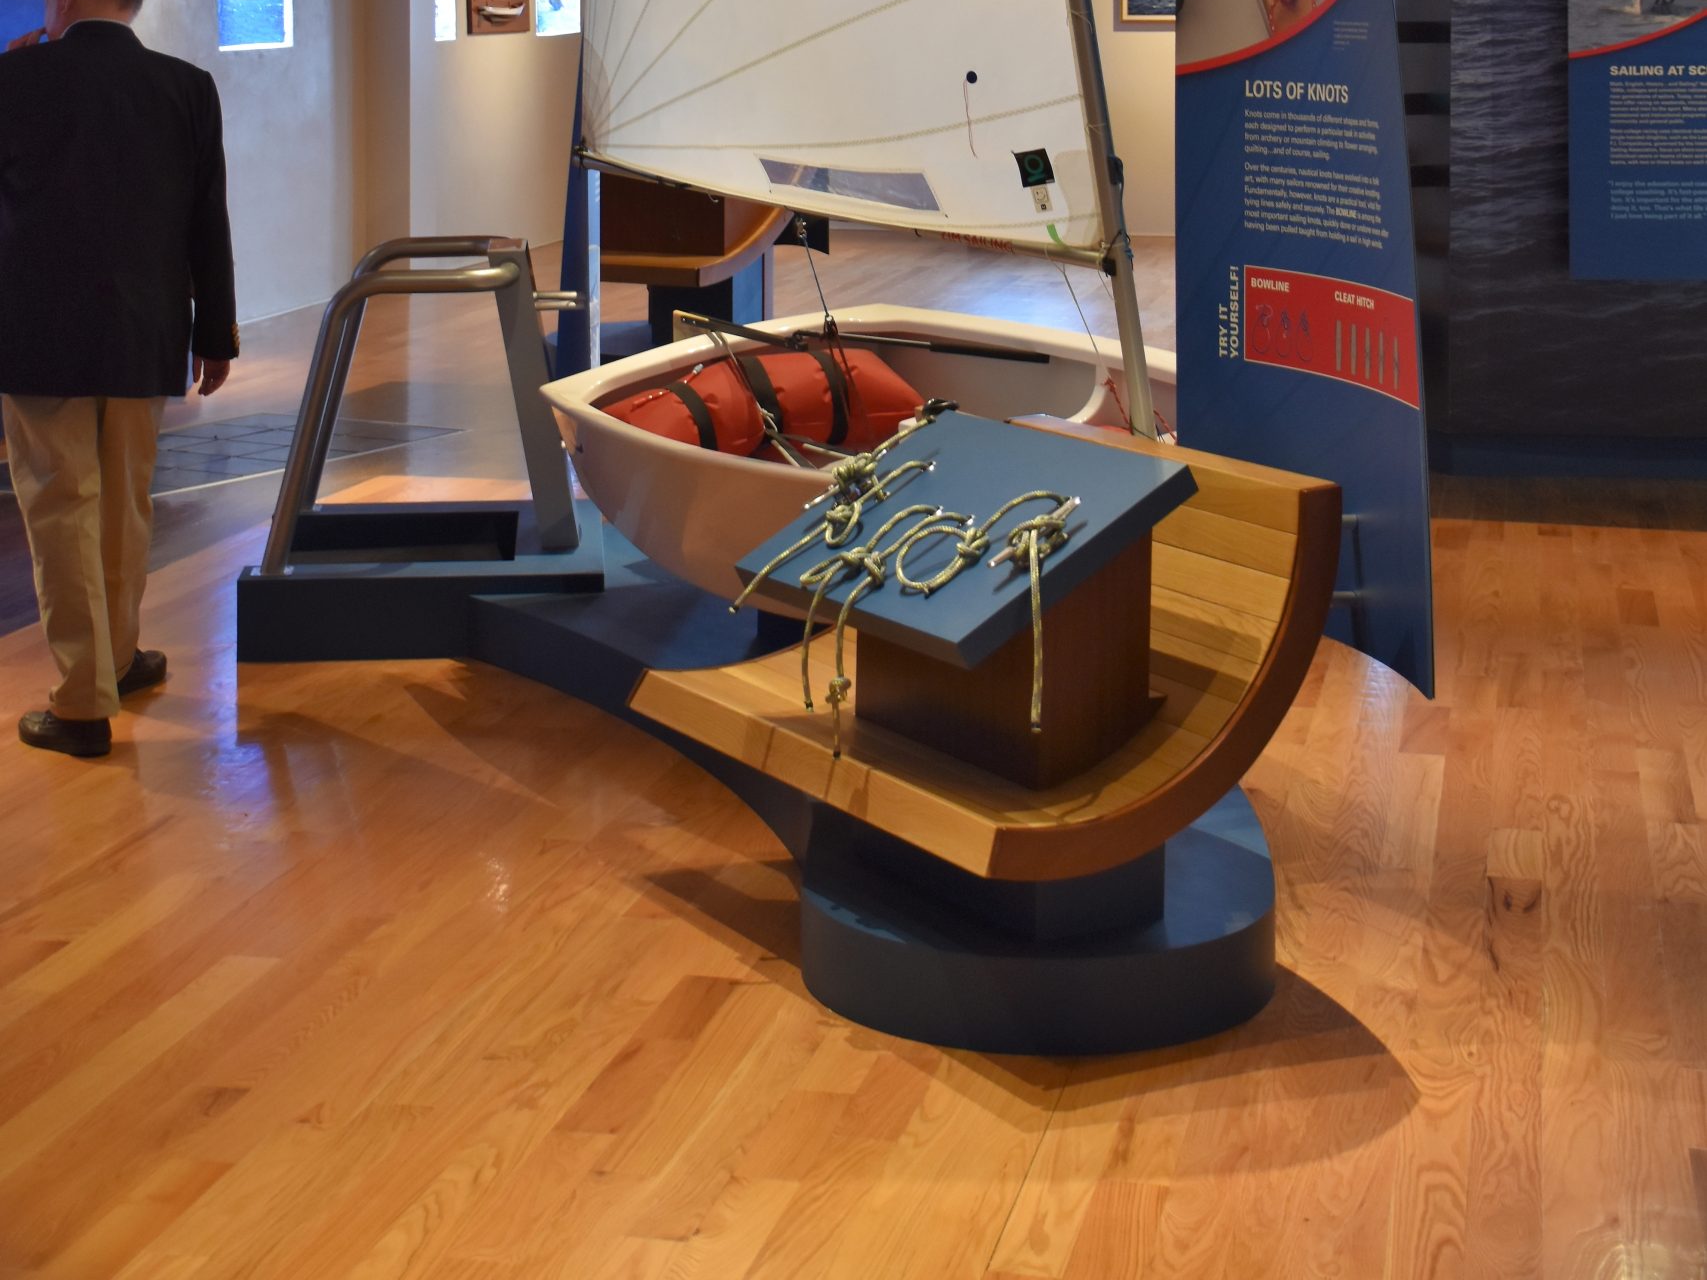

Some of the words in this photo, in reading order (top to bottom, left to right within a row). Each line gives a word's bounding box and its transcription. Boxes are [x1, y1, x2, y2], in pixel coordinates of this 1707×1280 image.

[1610, 65, 1664, 76] SAILING
[1667, 65, 1685, 76] AT
[1688, 65, 1707, 76] SC
[1245, 79, 1283, 99] LOTS
[1286, 81, 1305, 100] OF
[1308, 82, 1349, 104] KNOTS
[1245, 109, 1262, 118] Knots
[1263, 111, 1280, 119] come
[1245, 132, 1260, 141] from
[1245, 162, 1259, 171] Over
[1260, 163, 1270, 172] the
[1256, 176, 1269, 184] with
[1269, 177, 1285, 187] many
[1244, 209, 1260, 217] most
[1244, 219, 1265, 231] having
[1265, 222, 1280, 231] been
[1250, 277, 1290, 293] BOWLINE
[1334, 290, 1355, 305] CLEAT
[1356, 295, 1375, 311] HITCH
[1218, 303, 1228, 320] IT
[1229, 265, 1239, 358] YOURSELF!
[1218, 324, 1228, 358] TRY
